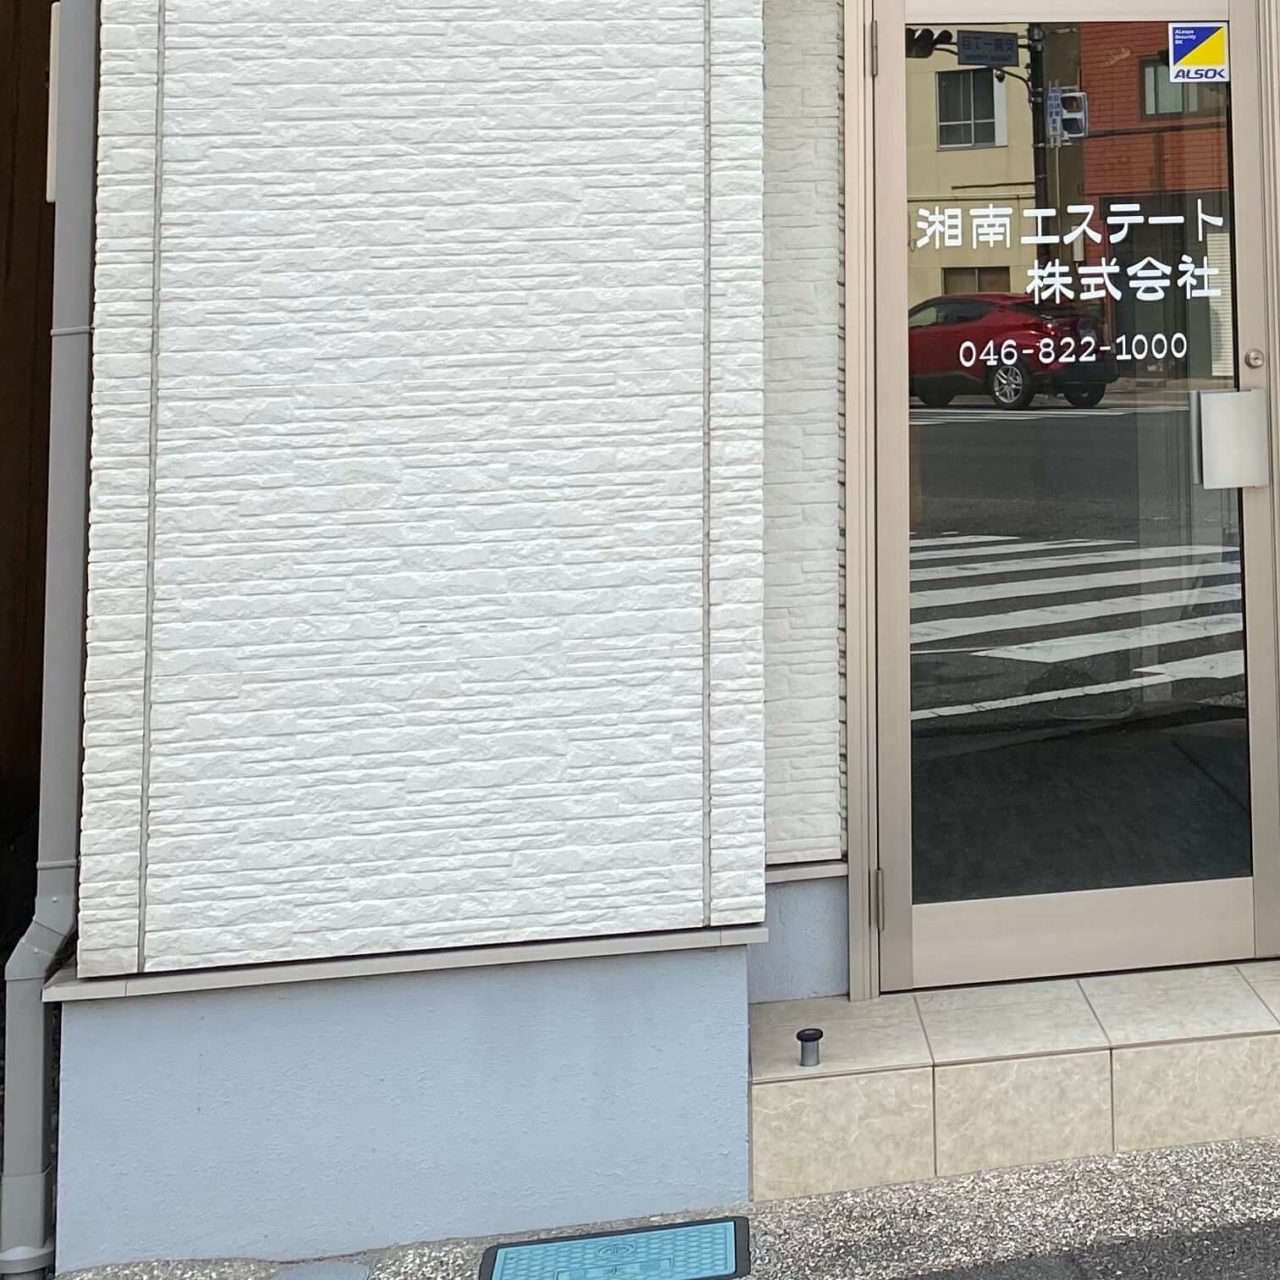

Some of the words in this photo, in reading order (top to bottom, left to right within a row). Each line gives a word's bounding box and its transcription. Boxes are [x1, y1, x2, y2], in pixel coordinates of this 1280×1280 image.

[1174, 68, 1226, 79] ALSOK
[916, 198, 1224, 249] 湘南エステート
[1026, 254, 1222, 305] 株式会社
[959, 332, 1188, 368] 046-822-1000
